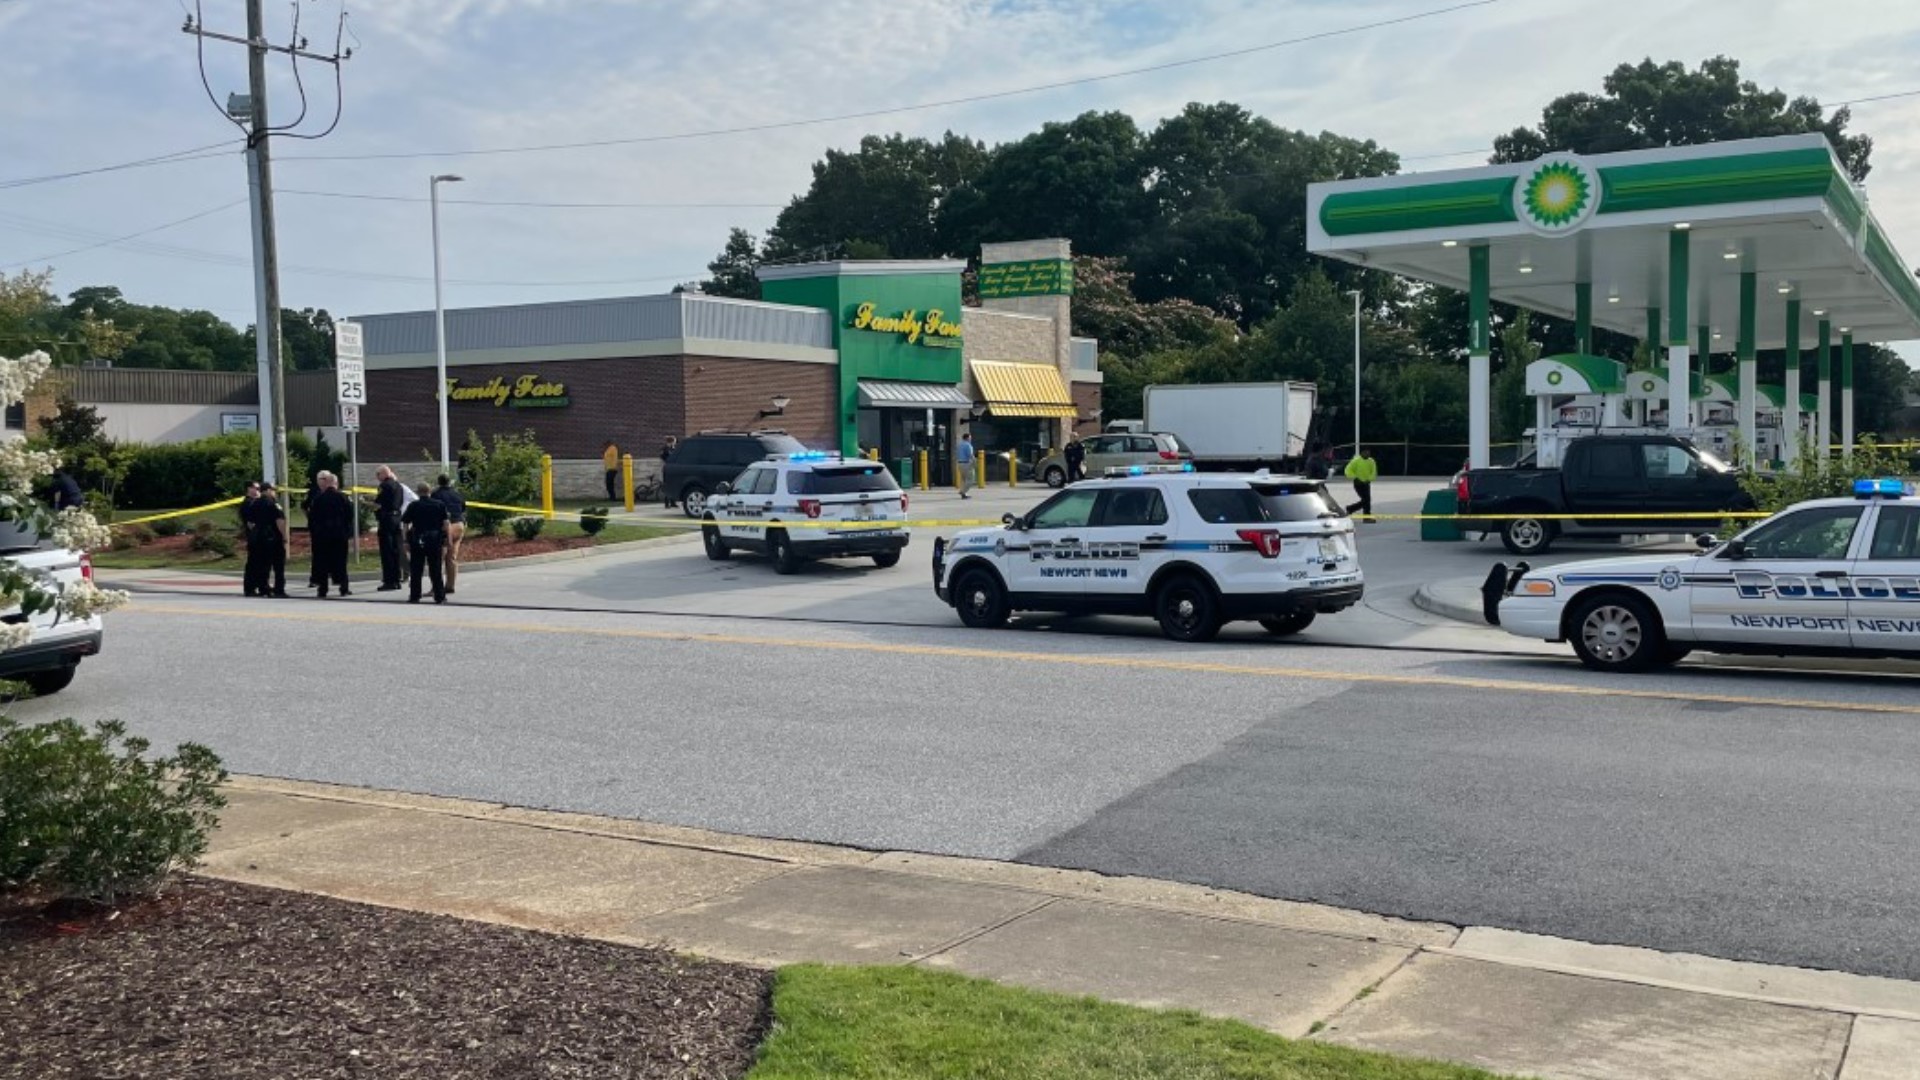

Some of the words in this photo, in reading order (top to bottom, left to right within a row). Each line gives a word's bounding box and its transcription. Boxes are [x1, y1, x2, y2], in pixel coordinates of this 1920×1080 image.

[855, 302, 921, 344] Family
[340, 361, 361, 372] SPEED
[342, 382, 362, 398] 25
[436, 376, 512, 407] Family
[514, 374, 564, 398] Fare
[1030, 541, 1139, 562] POLICE
[1040, 567, 1092, 578] NEWPORT
[1094, 568, 1128, 578] NEWS
[1730, 569, 1920, 600] POLICE
[1730, 614, 1847, 631] NEWPORT
